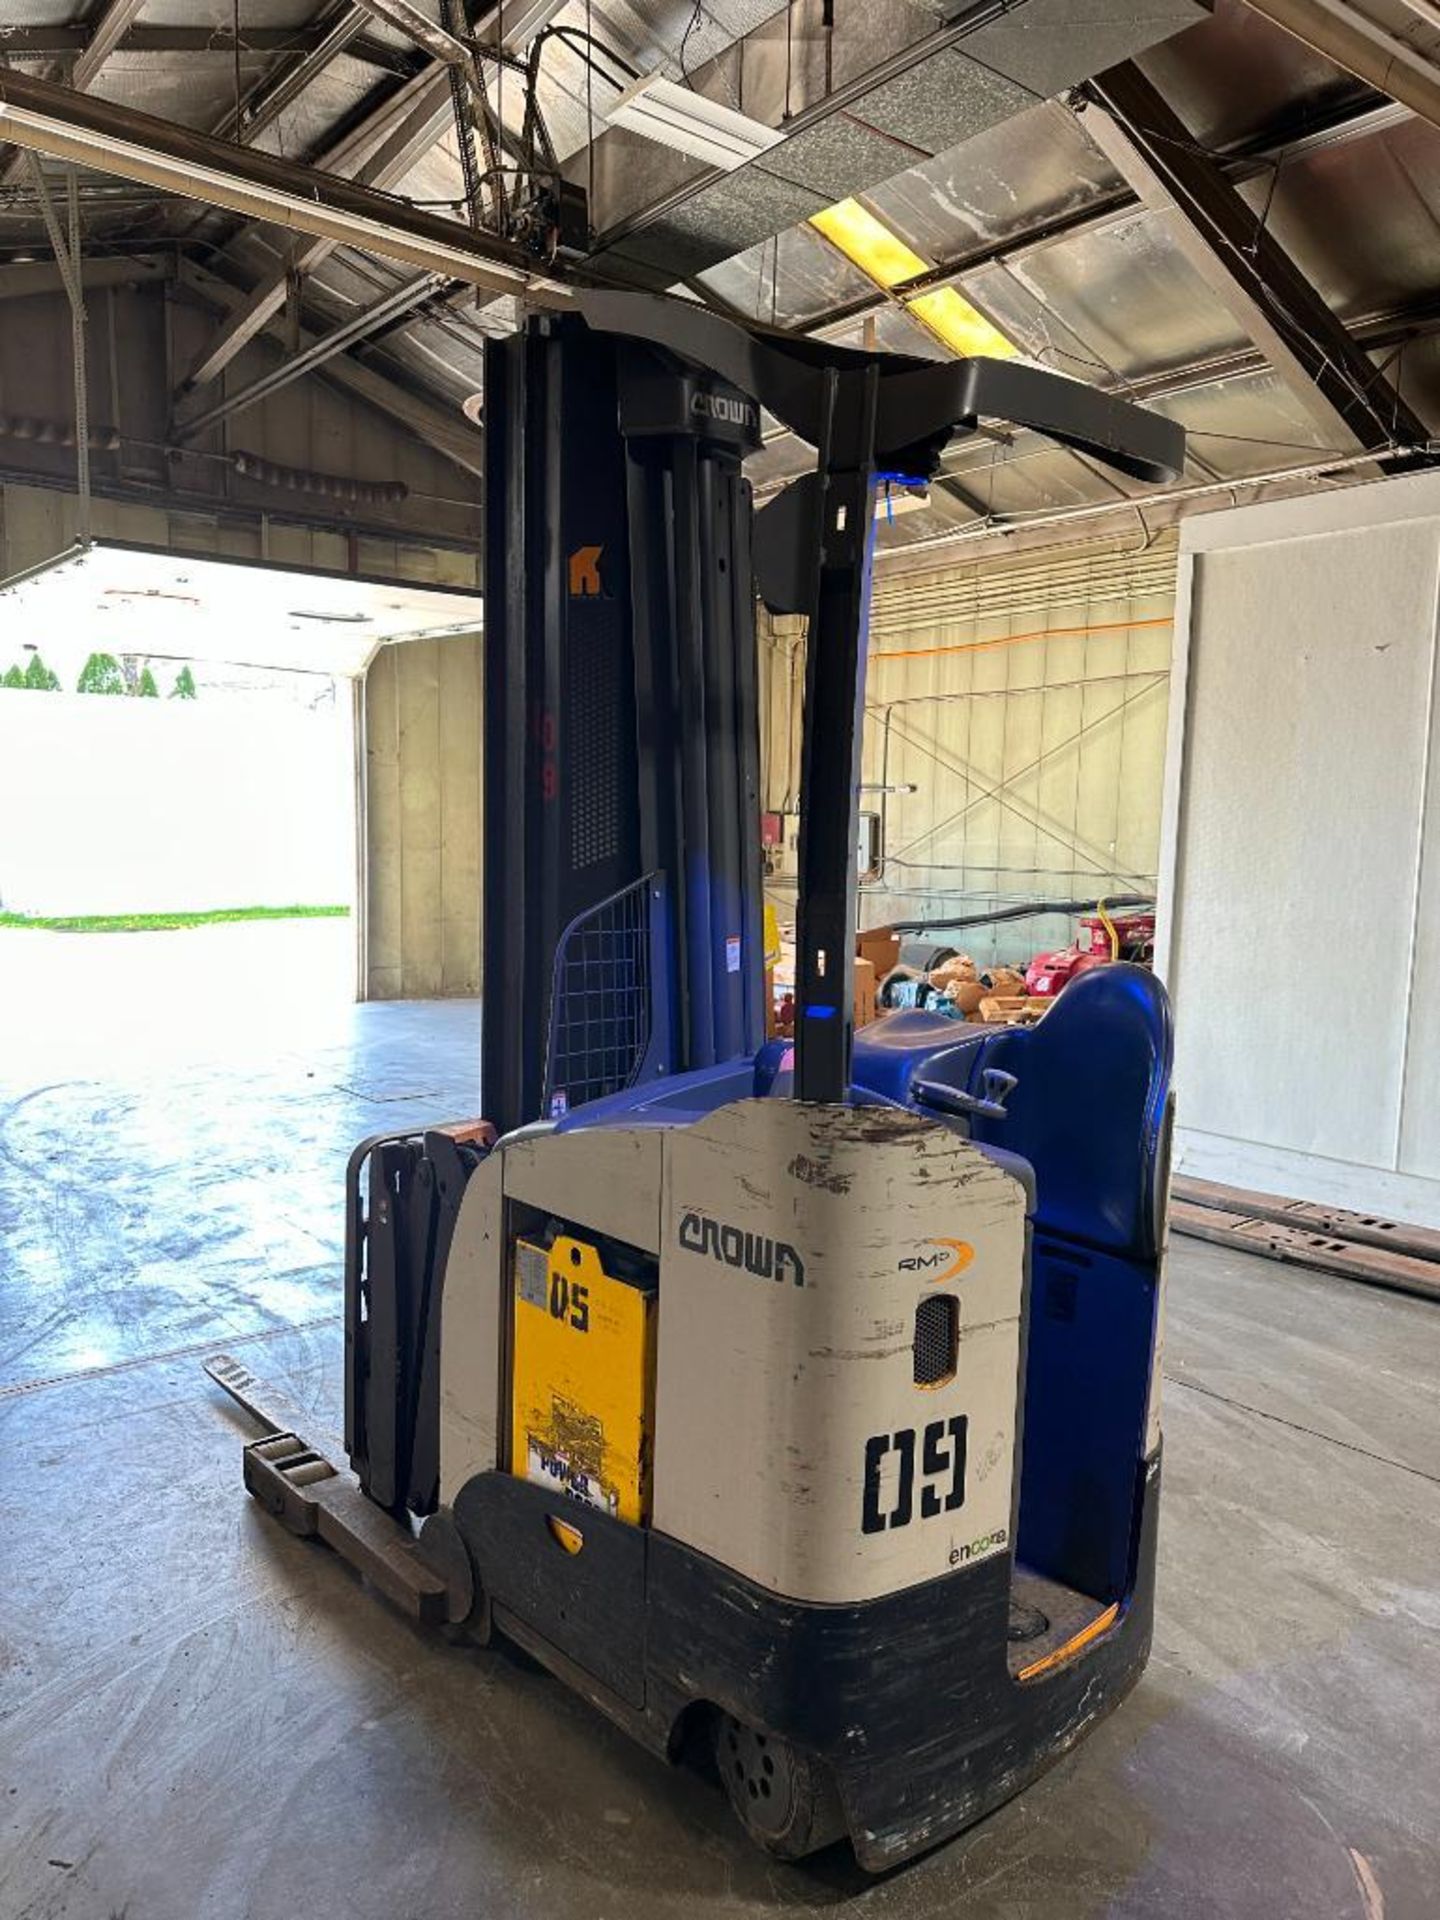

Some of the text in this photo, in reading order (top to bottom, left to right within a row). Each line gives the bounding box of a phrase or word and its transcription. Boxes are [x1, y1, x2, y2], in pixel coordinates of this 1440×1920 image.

[691, 392, 758, 427] CROWN
[680, 1213, 804, 1287] CROWN
[550, 1272, 589, 1333] 05
[862, 1414, 968, 1534] 09
[949, 1528, 1007, 1565] encore
